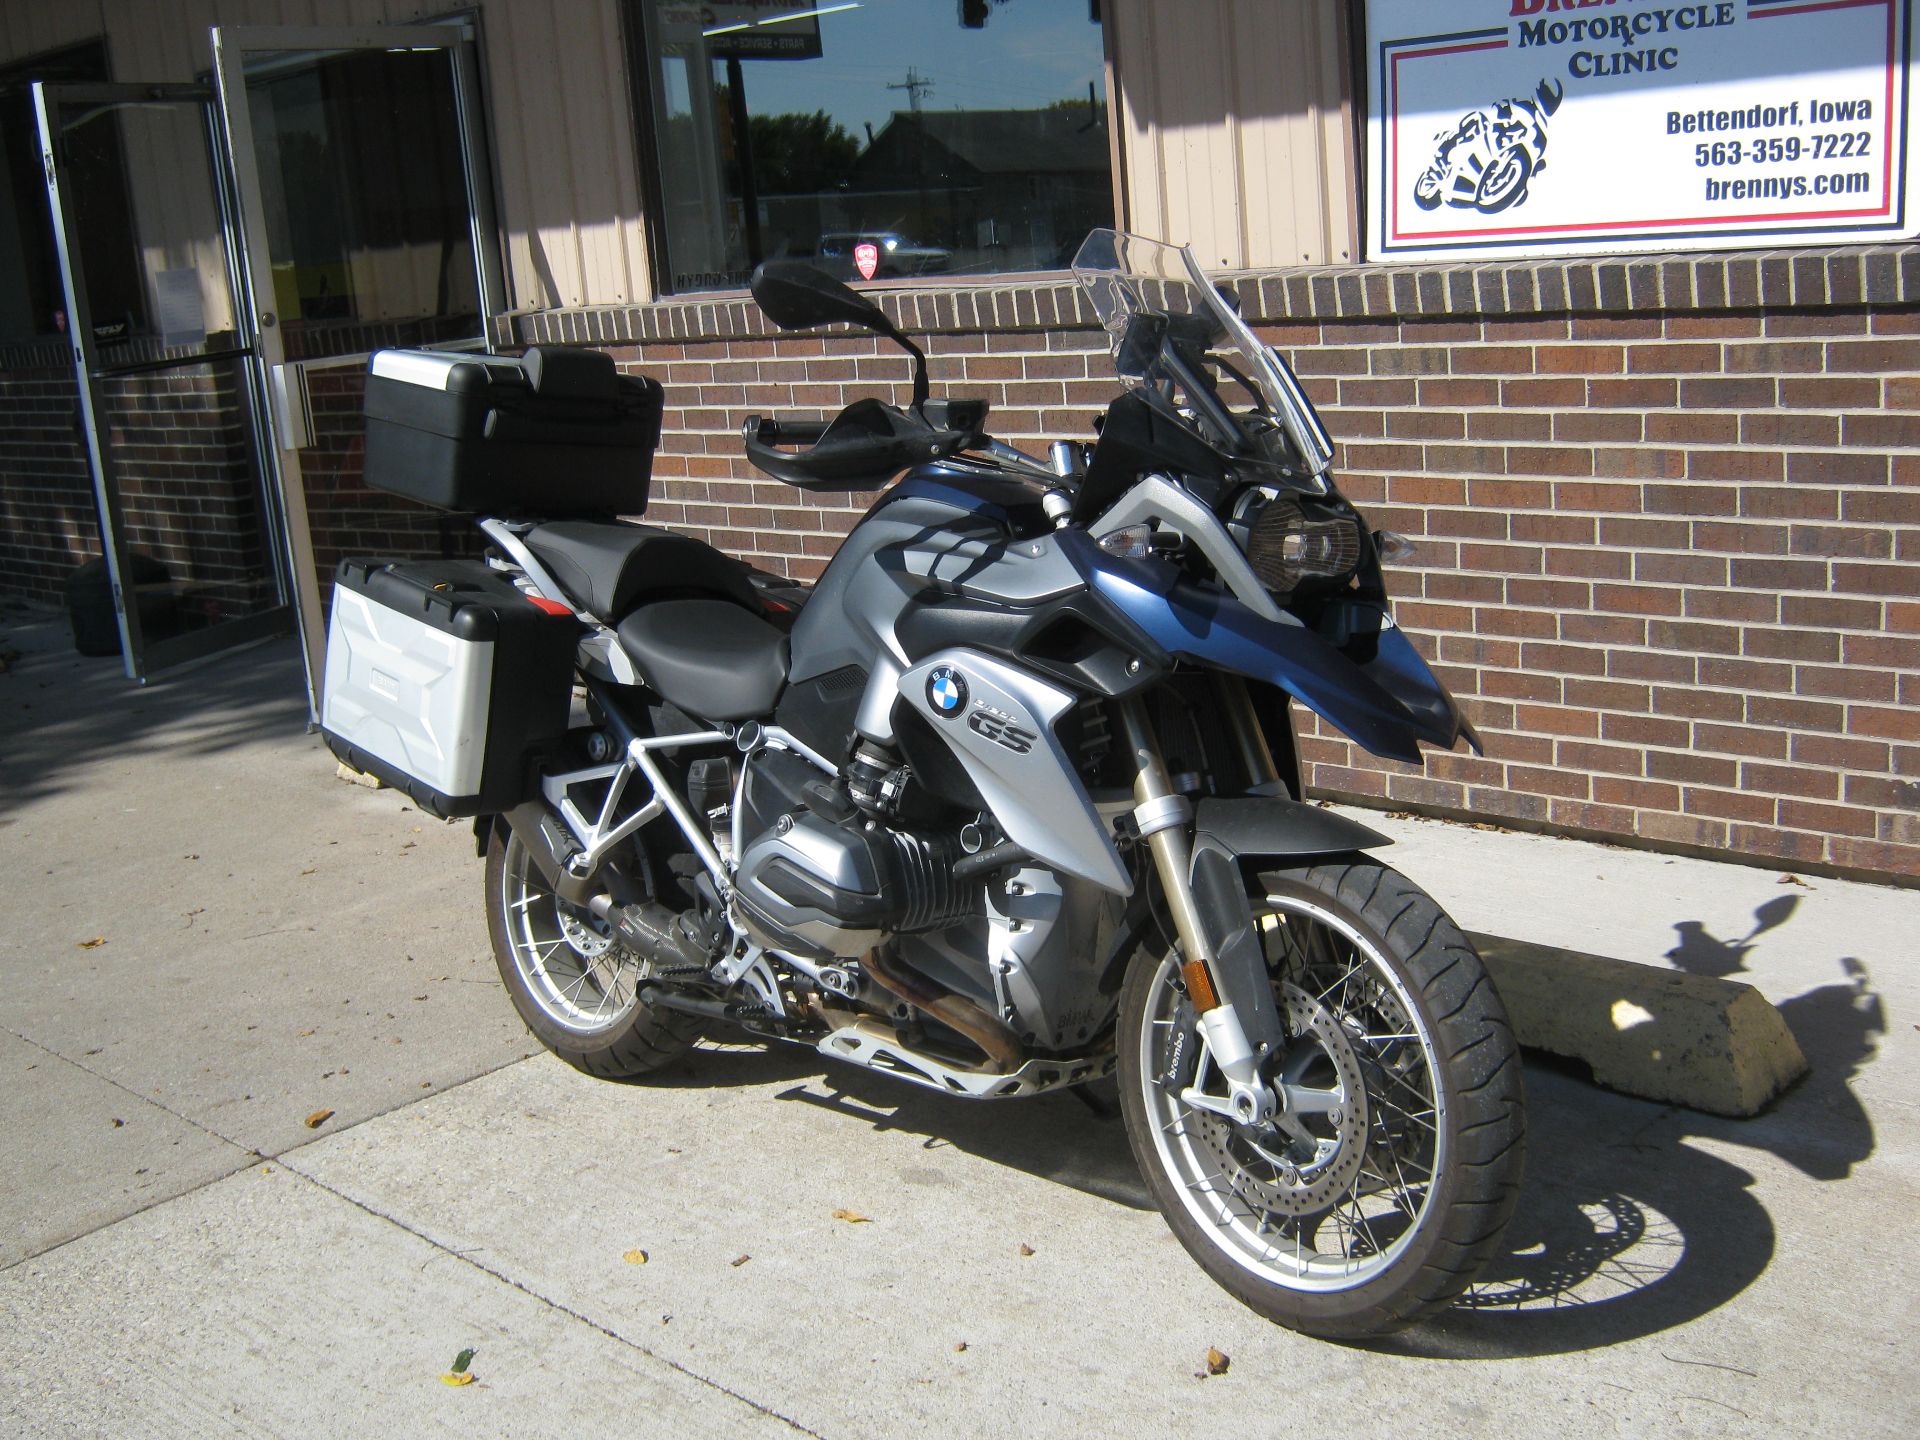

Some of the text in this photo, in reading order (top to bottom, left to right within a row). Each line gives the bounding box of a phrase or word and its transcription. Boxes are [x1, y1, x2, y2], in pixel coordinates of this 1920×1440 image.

[1568, 47, 1678, 79] CLINIC
[1666, 99, 1873, 135] Bettendorf, Iowa
[1695, 131, 1872, 167] 563-359-7222
[1705, 172, 1870, 201] brennys.com
[968, 711, 1038, 755] GS
[1167, 1032, 1185, 1080] brembo
